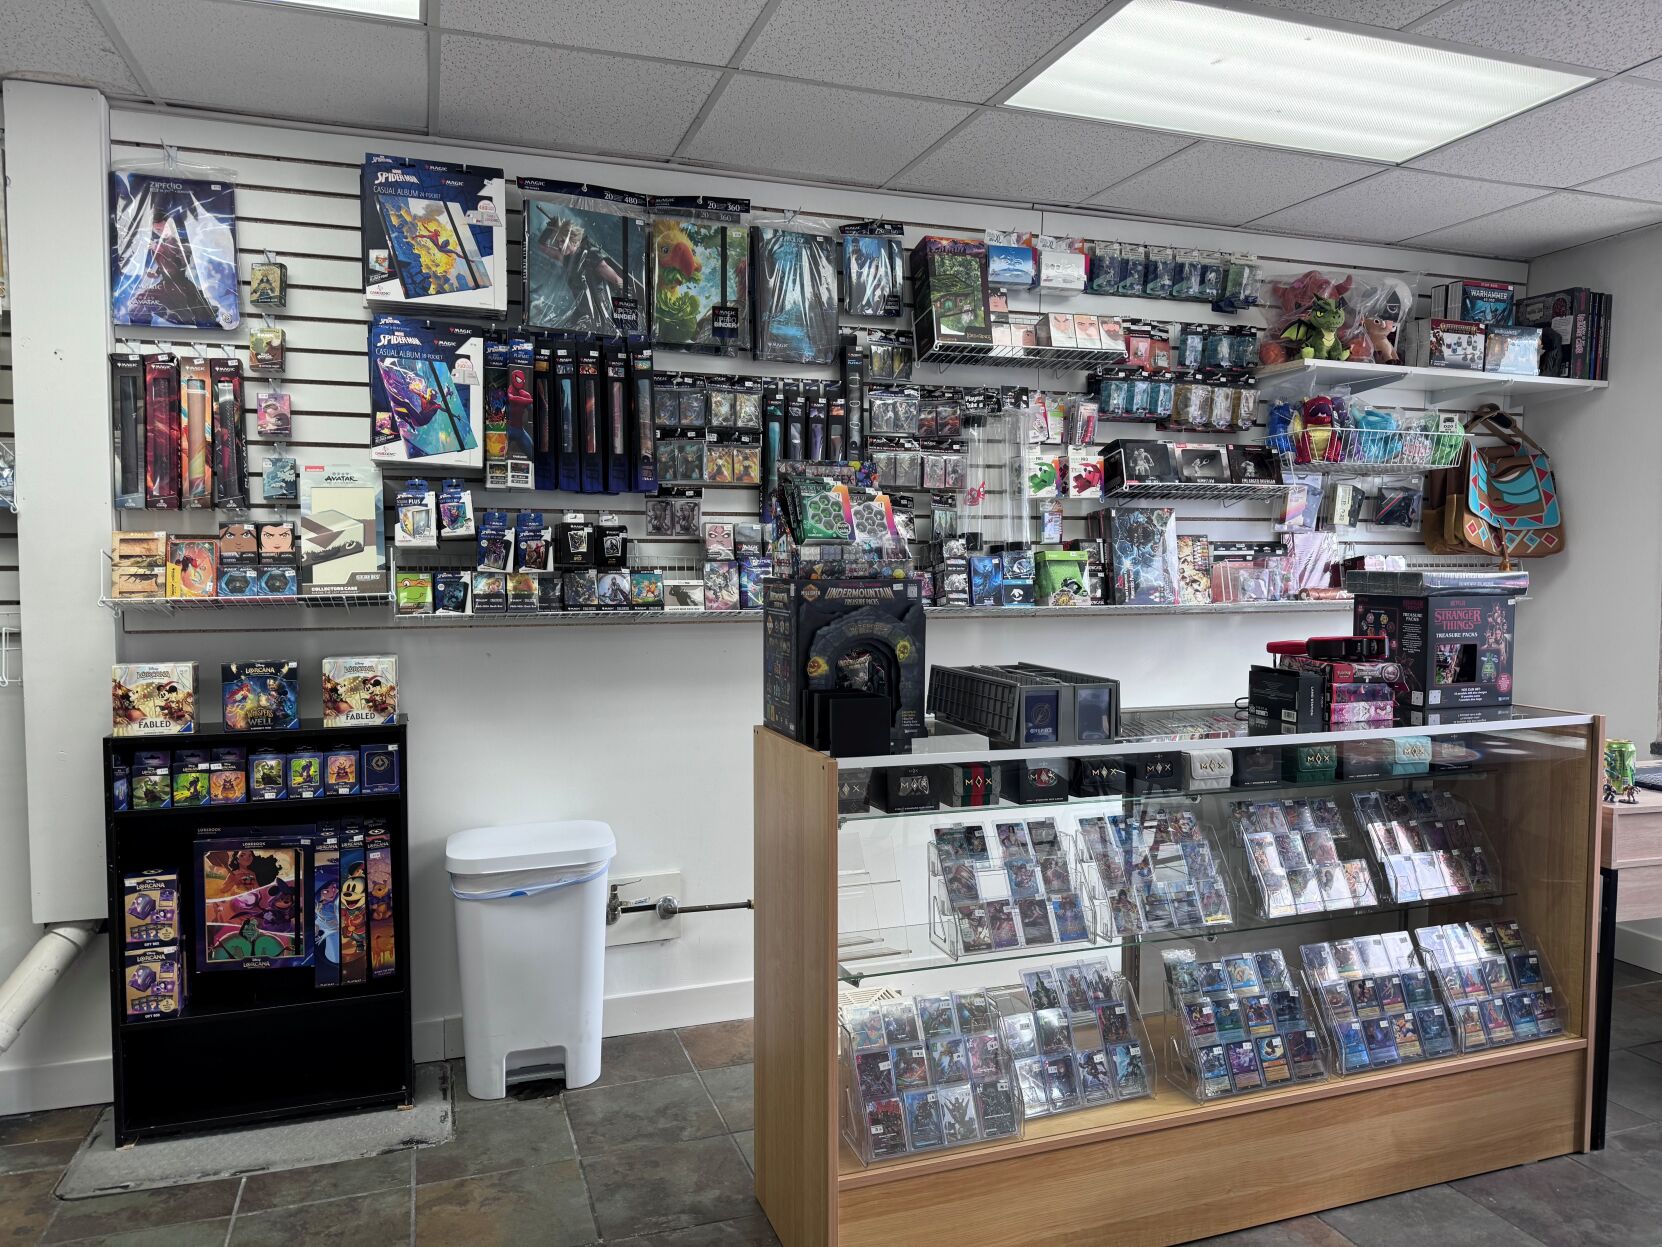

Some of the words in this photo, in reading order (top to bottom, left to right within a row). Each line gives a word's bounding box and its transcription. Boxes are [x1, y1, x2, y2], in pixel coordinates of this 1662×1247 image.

[373, 185, 396, 195] CASUAL
[397, 189, 418, 197] ALBUM
[624, 195, 638, 204] 480
[707, 201, 717, 209] 20
[727, 203, 740, 212] 360
[1470, 289, 1508, 299] WARHAMMER
[375, 348, 397, 356] CASUAL
[399, 350, 420, 358] ALBUM
[742, 544, 759, 552] MAGIC
[825, 587, 895, 599] UNDERMOUNTAIN
[1434, 608, 1482, 624] STRANGER
[1443, 621, 1474, 630] THINGS
[345, 712, 376, 721] FABLED
[138, 720, 171, 729] FABLED
